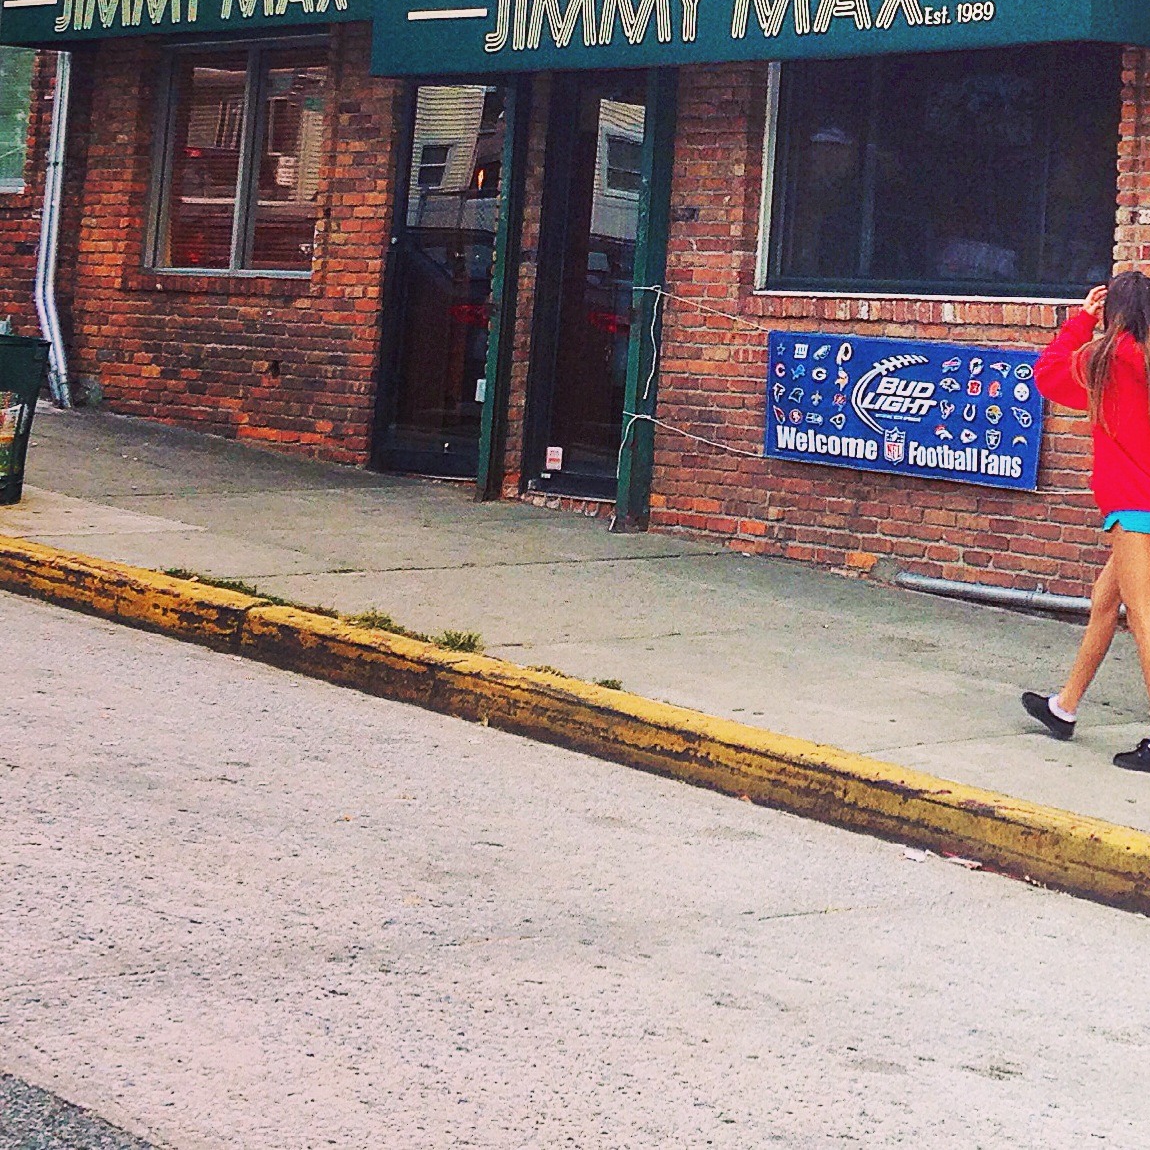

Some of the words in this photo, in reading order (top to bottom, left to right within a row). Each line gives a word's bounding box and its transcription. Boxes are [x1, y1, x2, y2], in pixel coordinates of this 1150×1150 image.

[924, 5, 952, 25] Est.
[957, 0, 995, 23] 1989
[876, 376, 936, 398] BUD
[861, 392, 938, 415] LIGHT
[776, 424, 878, 461] Welcome
[908, 440, 977, 472] Football
[980, 448, 1022, 478] Fans
